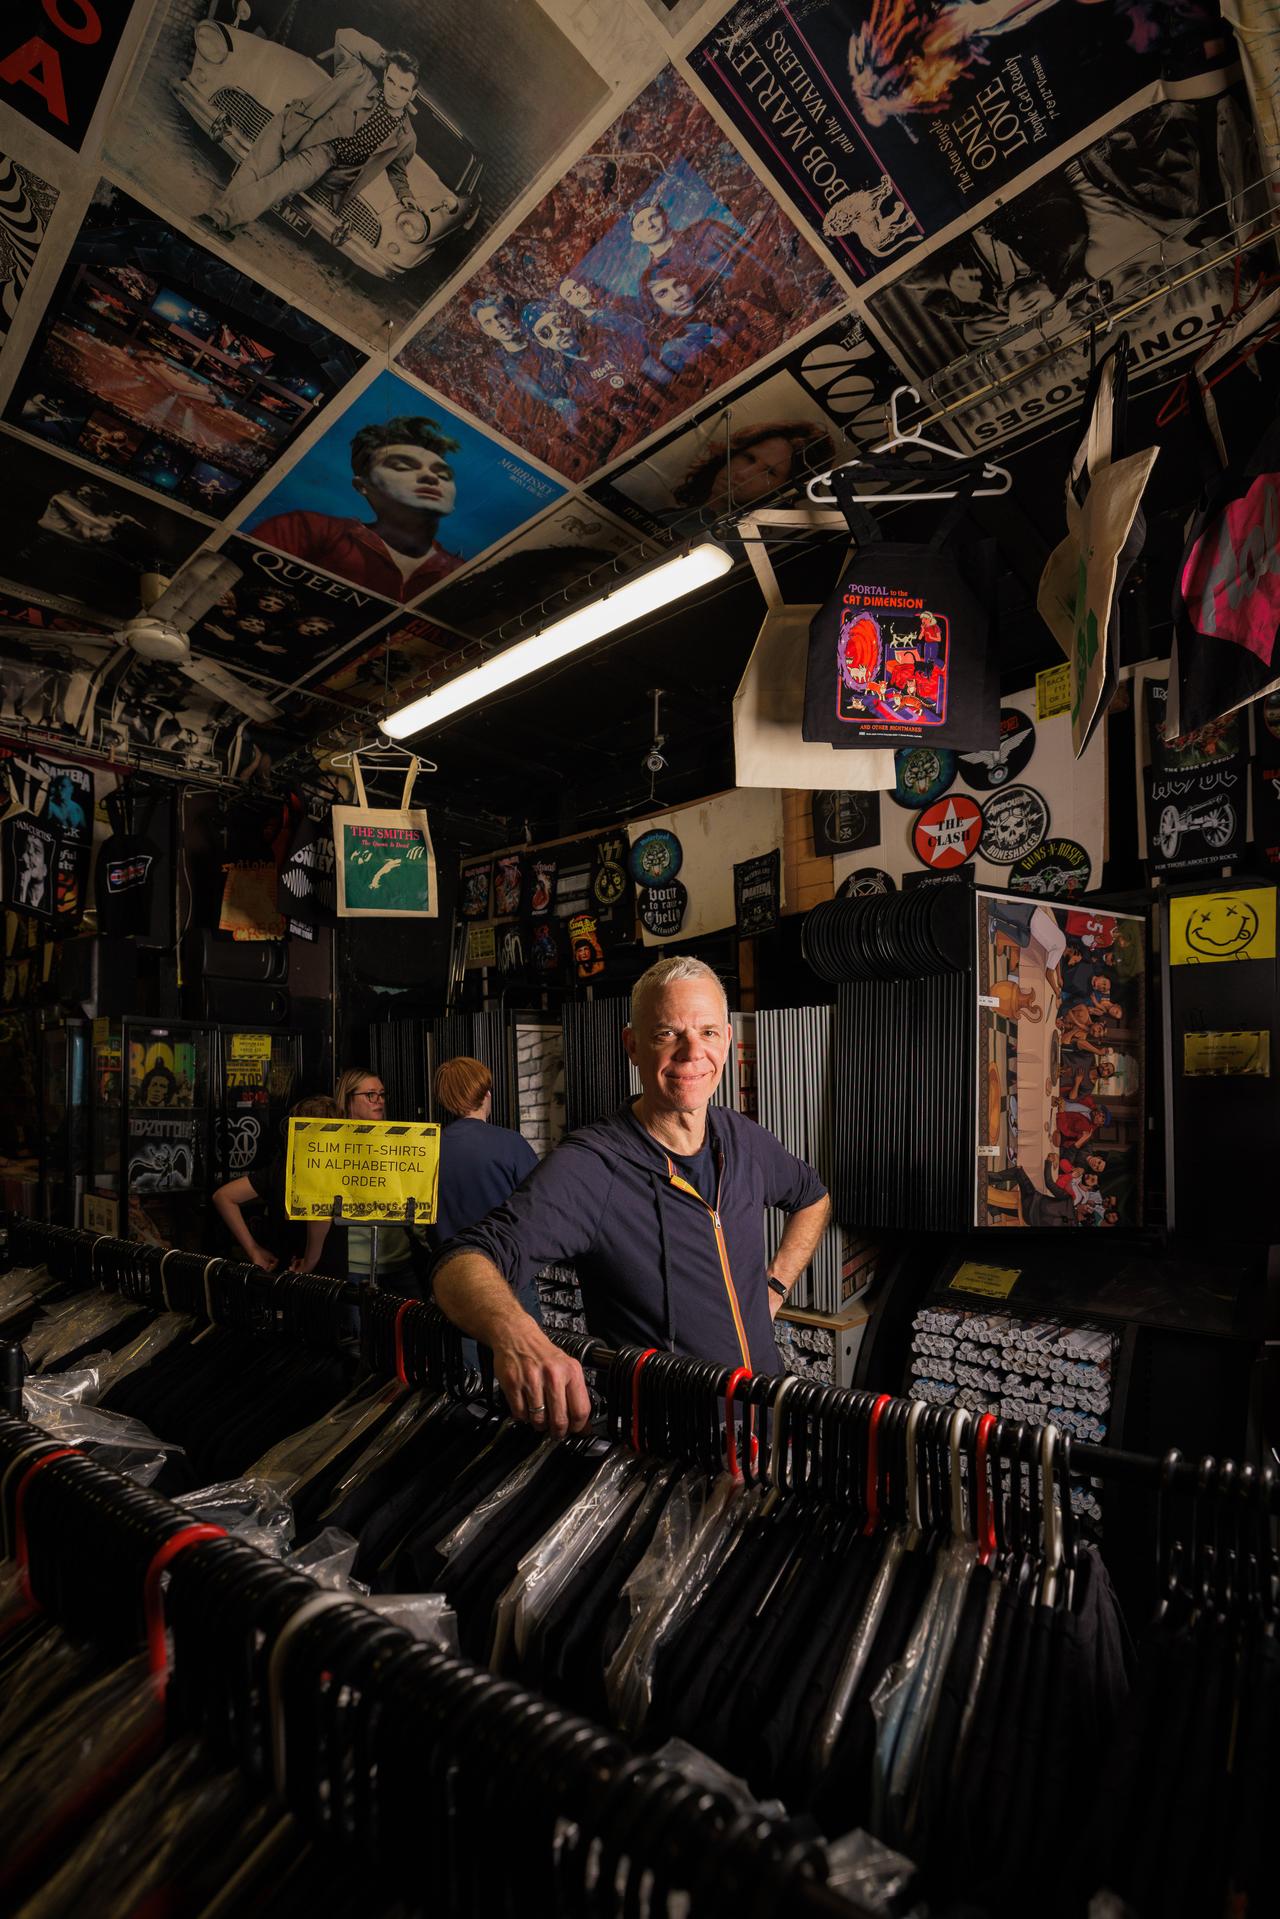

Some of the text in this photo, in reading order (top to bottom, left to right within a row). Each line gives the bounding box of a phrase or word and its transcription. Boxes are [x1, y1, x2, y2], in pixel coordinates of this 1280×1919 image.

[765, 30, 828, 124] WAILERS
[1001, 54, 1047, 143] People Get Ready
[715, 27, 850, 205] BOB MARLEY
[976, 77, 1029, 159] LOVE
[952, 105, 997, 171] ONE
[929, 119, 976, 194] The New Single
[1122, 303, 1231, 366] TONE
[251, 550, 370, 609] QUEEN
[848, 583, 889, 596] PORTAL
[842, 593, 924, 609] CAT DIMENSION
[350, 825, 420, 841] THE SMITHS
[936, 816, 964, 831] THE
[927, 829, 970, 849] CLASH
[987, 831, 1040, 861] BONESHAKER
[307, 1142, 427, 1157] SLIM FIT T-SHIRTS
[307, 1158, 424, 1173] IN ALPHABETICAL
[342, 1175, 387, 1188] ORDER
